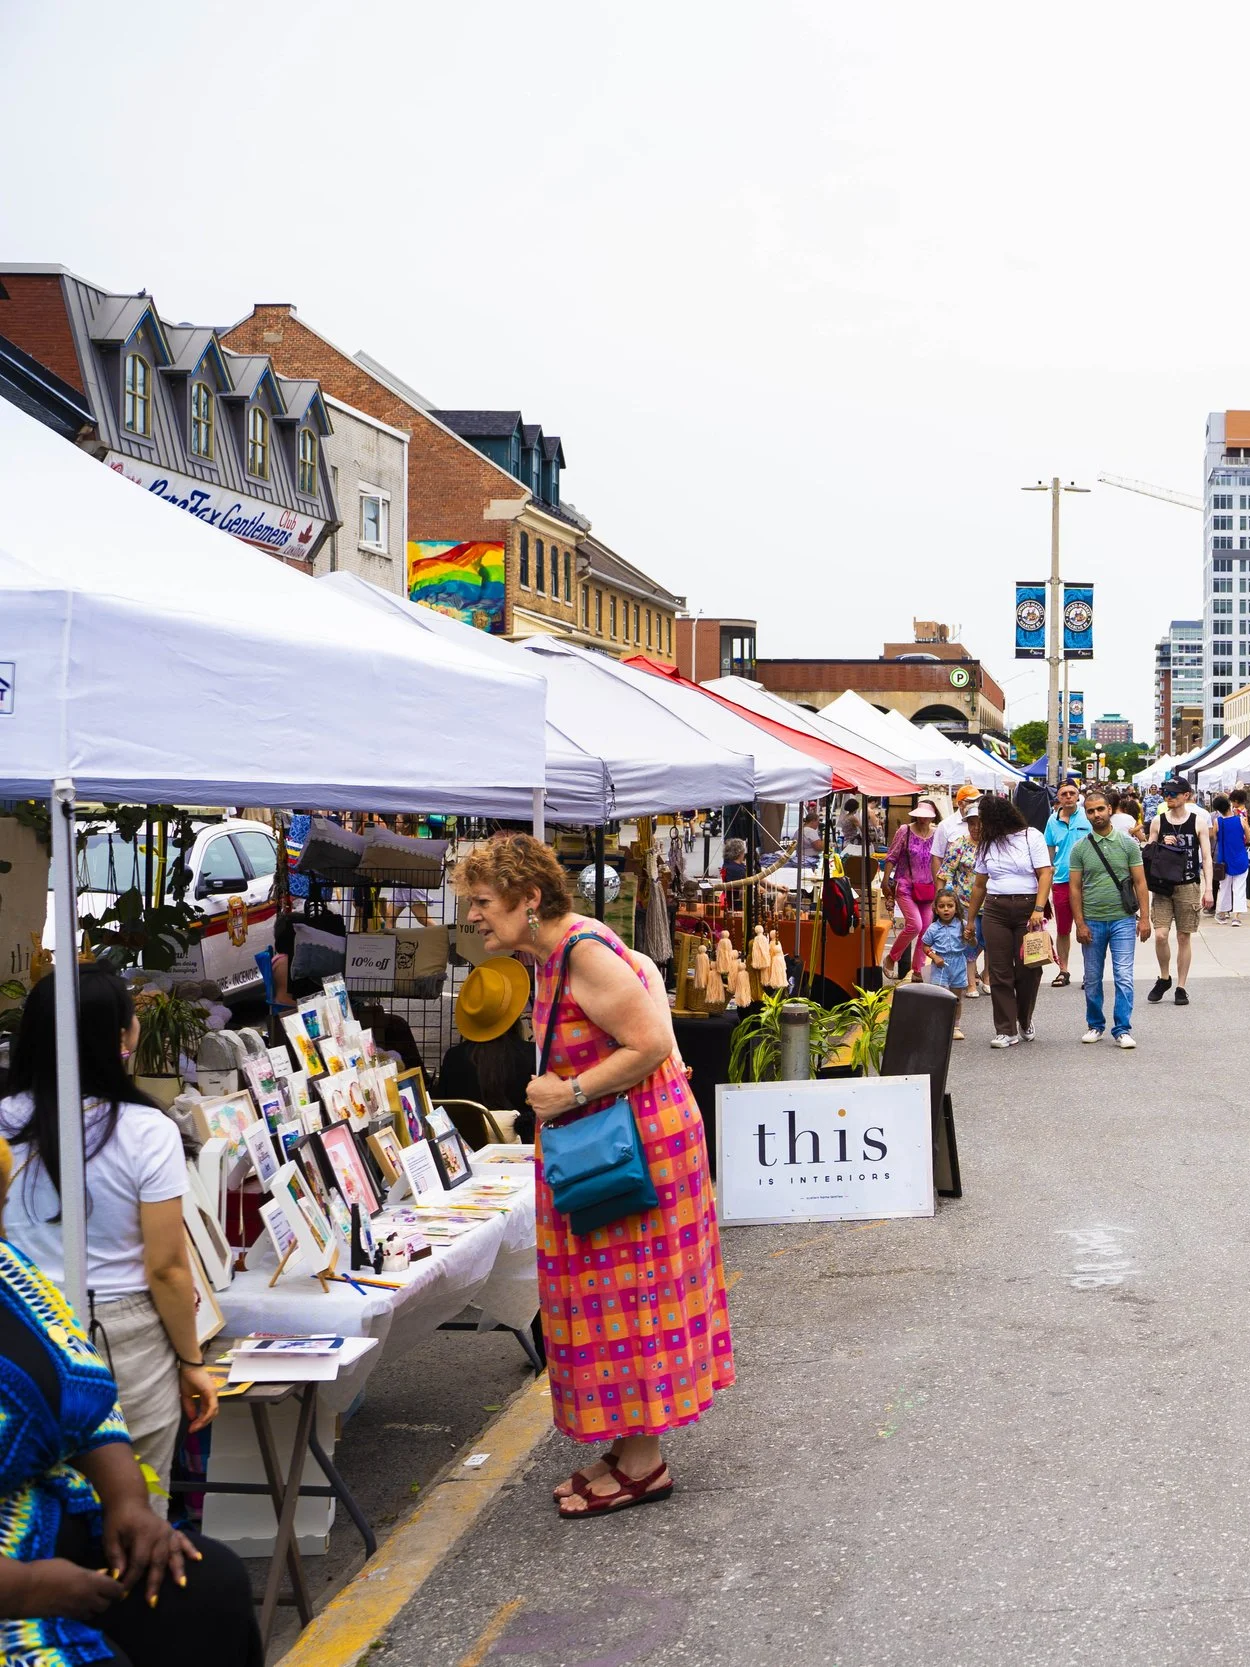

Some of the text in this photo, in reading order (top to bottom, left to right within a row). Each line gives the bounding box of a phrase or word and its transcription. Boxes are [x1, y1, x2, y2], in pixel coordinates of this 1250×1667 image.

[219, 503, 292, 546] Gentlemens
[279, 510, 297, 530] Club
[957, 673, 964, 682] P
[459, 924, 475, 933] YOU
[351, 957, 391, 970] 10% off
[752, 1108, 888, 1167] this
[790, 1172, 890, 1184] INTERIORS
